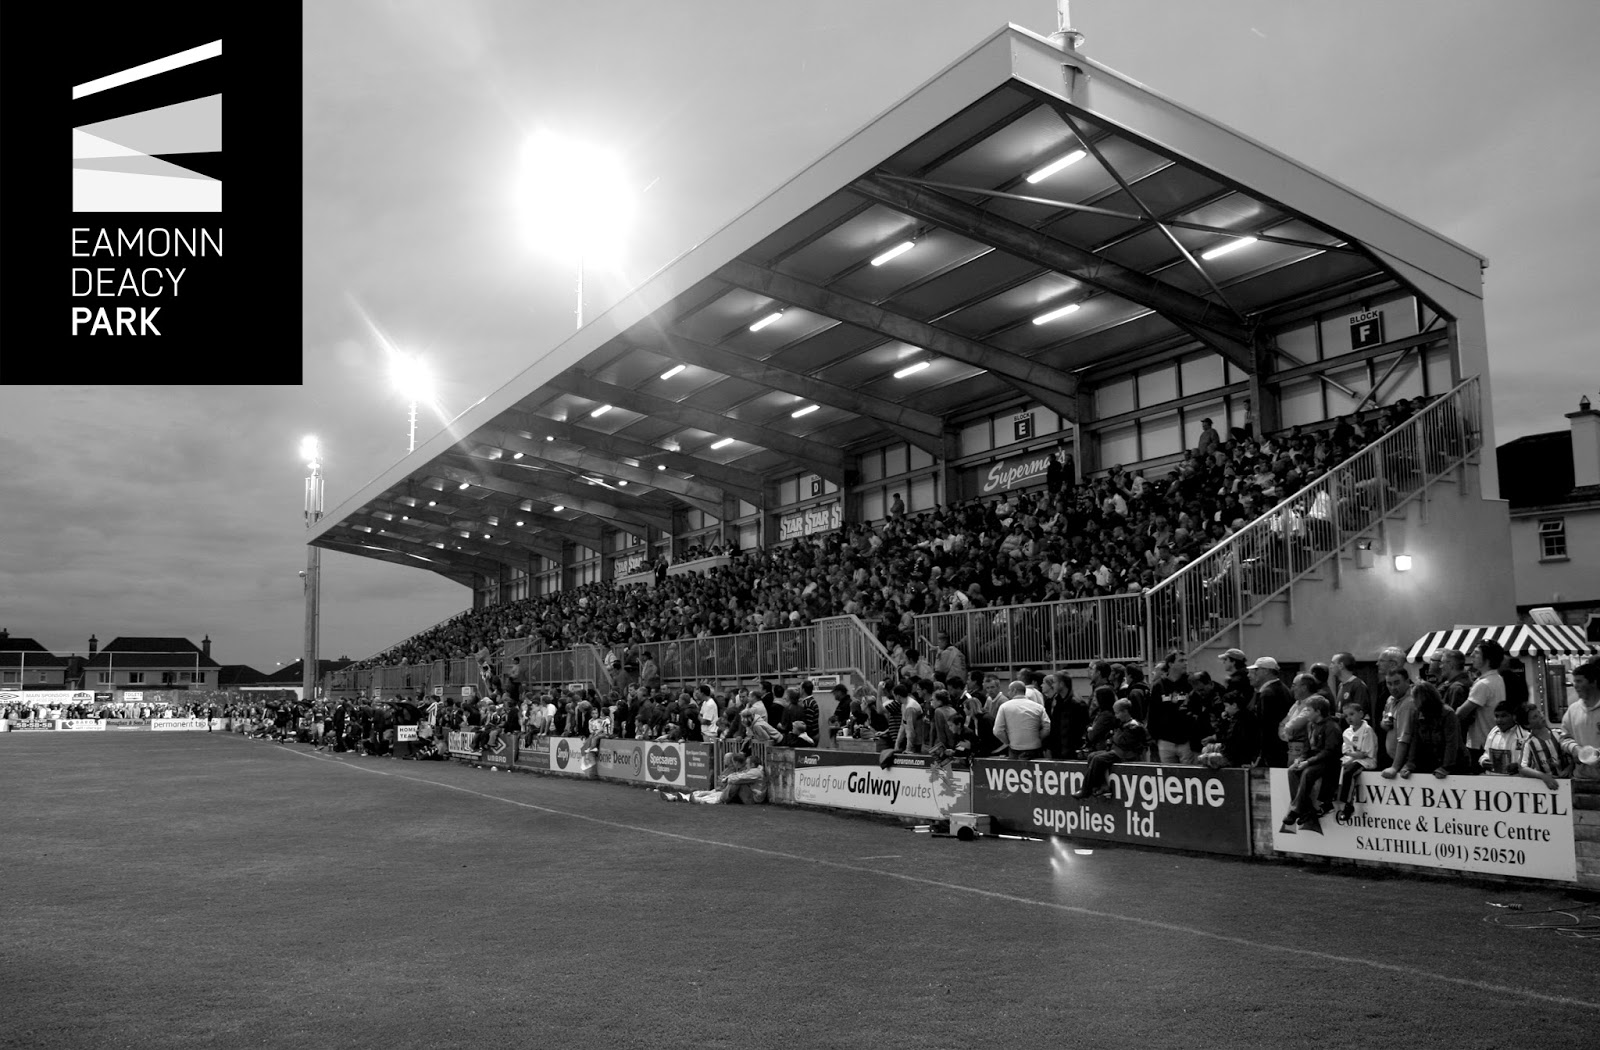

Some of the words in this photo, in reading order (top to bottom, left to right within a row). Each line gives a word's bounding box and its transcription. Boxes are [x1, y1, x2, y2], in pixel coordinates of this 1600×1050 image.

[1350, 310, 1378, 324] BLOCK
[1360, 325, 1371, 343] F
[1014, 413, 1030, 422] BLOCK
[1019, 422, 1027, 436] E
[983, 446, 1066, 492] Superma's
[814, 482, 819, 493] D
[780, 516, 803, 541] STAR
[805, 509, 829, 536] STAR
[831, 502, 843, 529] ST
[153, 721, 194, 729] permanent
[487, 754, 507, 763] UMBRO
[613, 750, 632, 765] Decor
[650, 752, 678, 766] Specsavers
[799, 773, 821, 788] Proud
[822, 774, 832, 793] of
[832, 778, 846, 790] our
[847, 771, 902, 805] Galway
[901, 785, 932, 802] routes
[985, 764, 1085, 796] western
[1355, 785, 1415, 807] LWAY
[1421, 787, 1467, 810] BAY
[1473, 790, 1568, 816] HOTEL
[1033, 805, 1115, 834] supplies
[1126, 809, 1160, 838] ltd.
[1336, 810, 1411, 831] Conference
[1415, 815, 1429, 832] &
[1434, 816, 1489, 838] Leisure
[1494, 820, 1551, 842] Centre
[1356, 835, 1432, 856] SALTHILL
[1434, 843, 1469, 863] (091)
[1473, 846, 1526, 866] 520520
